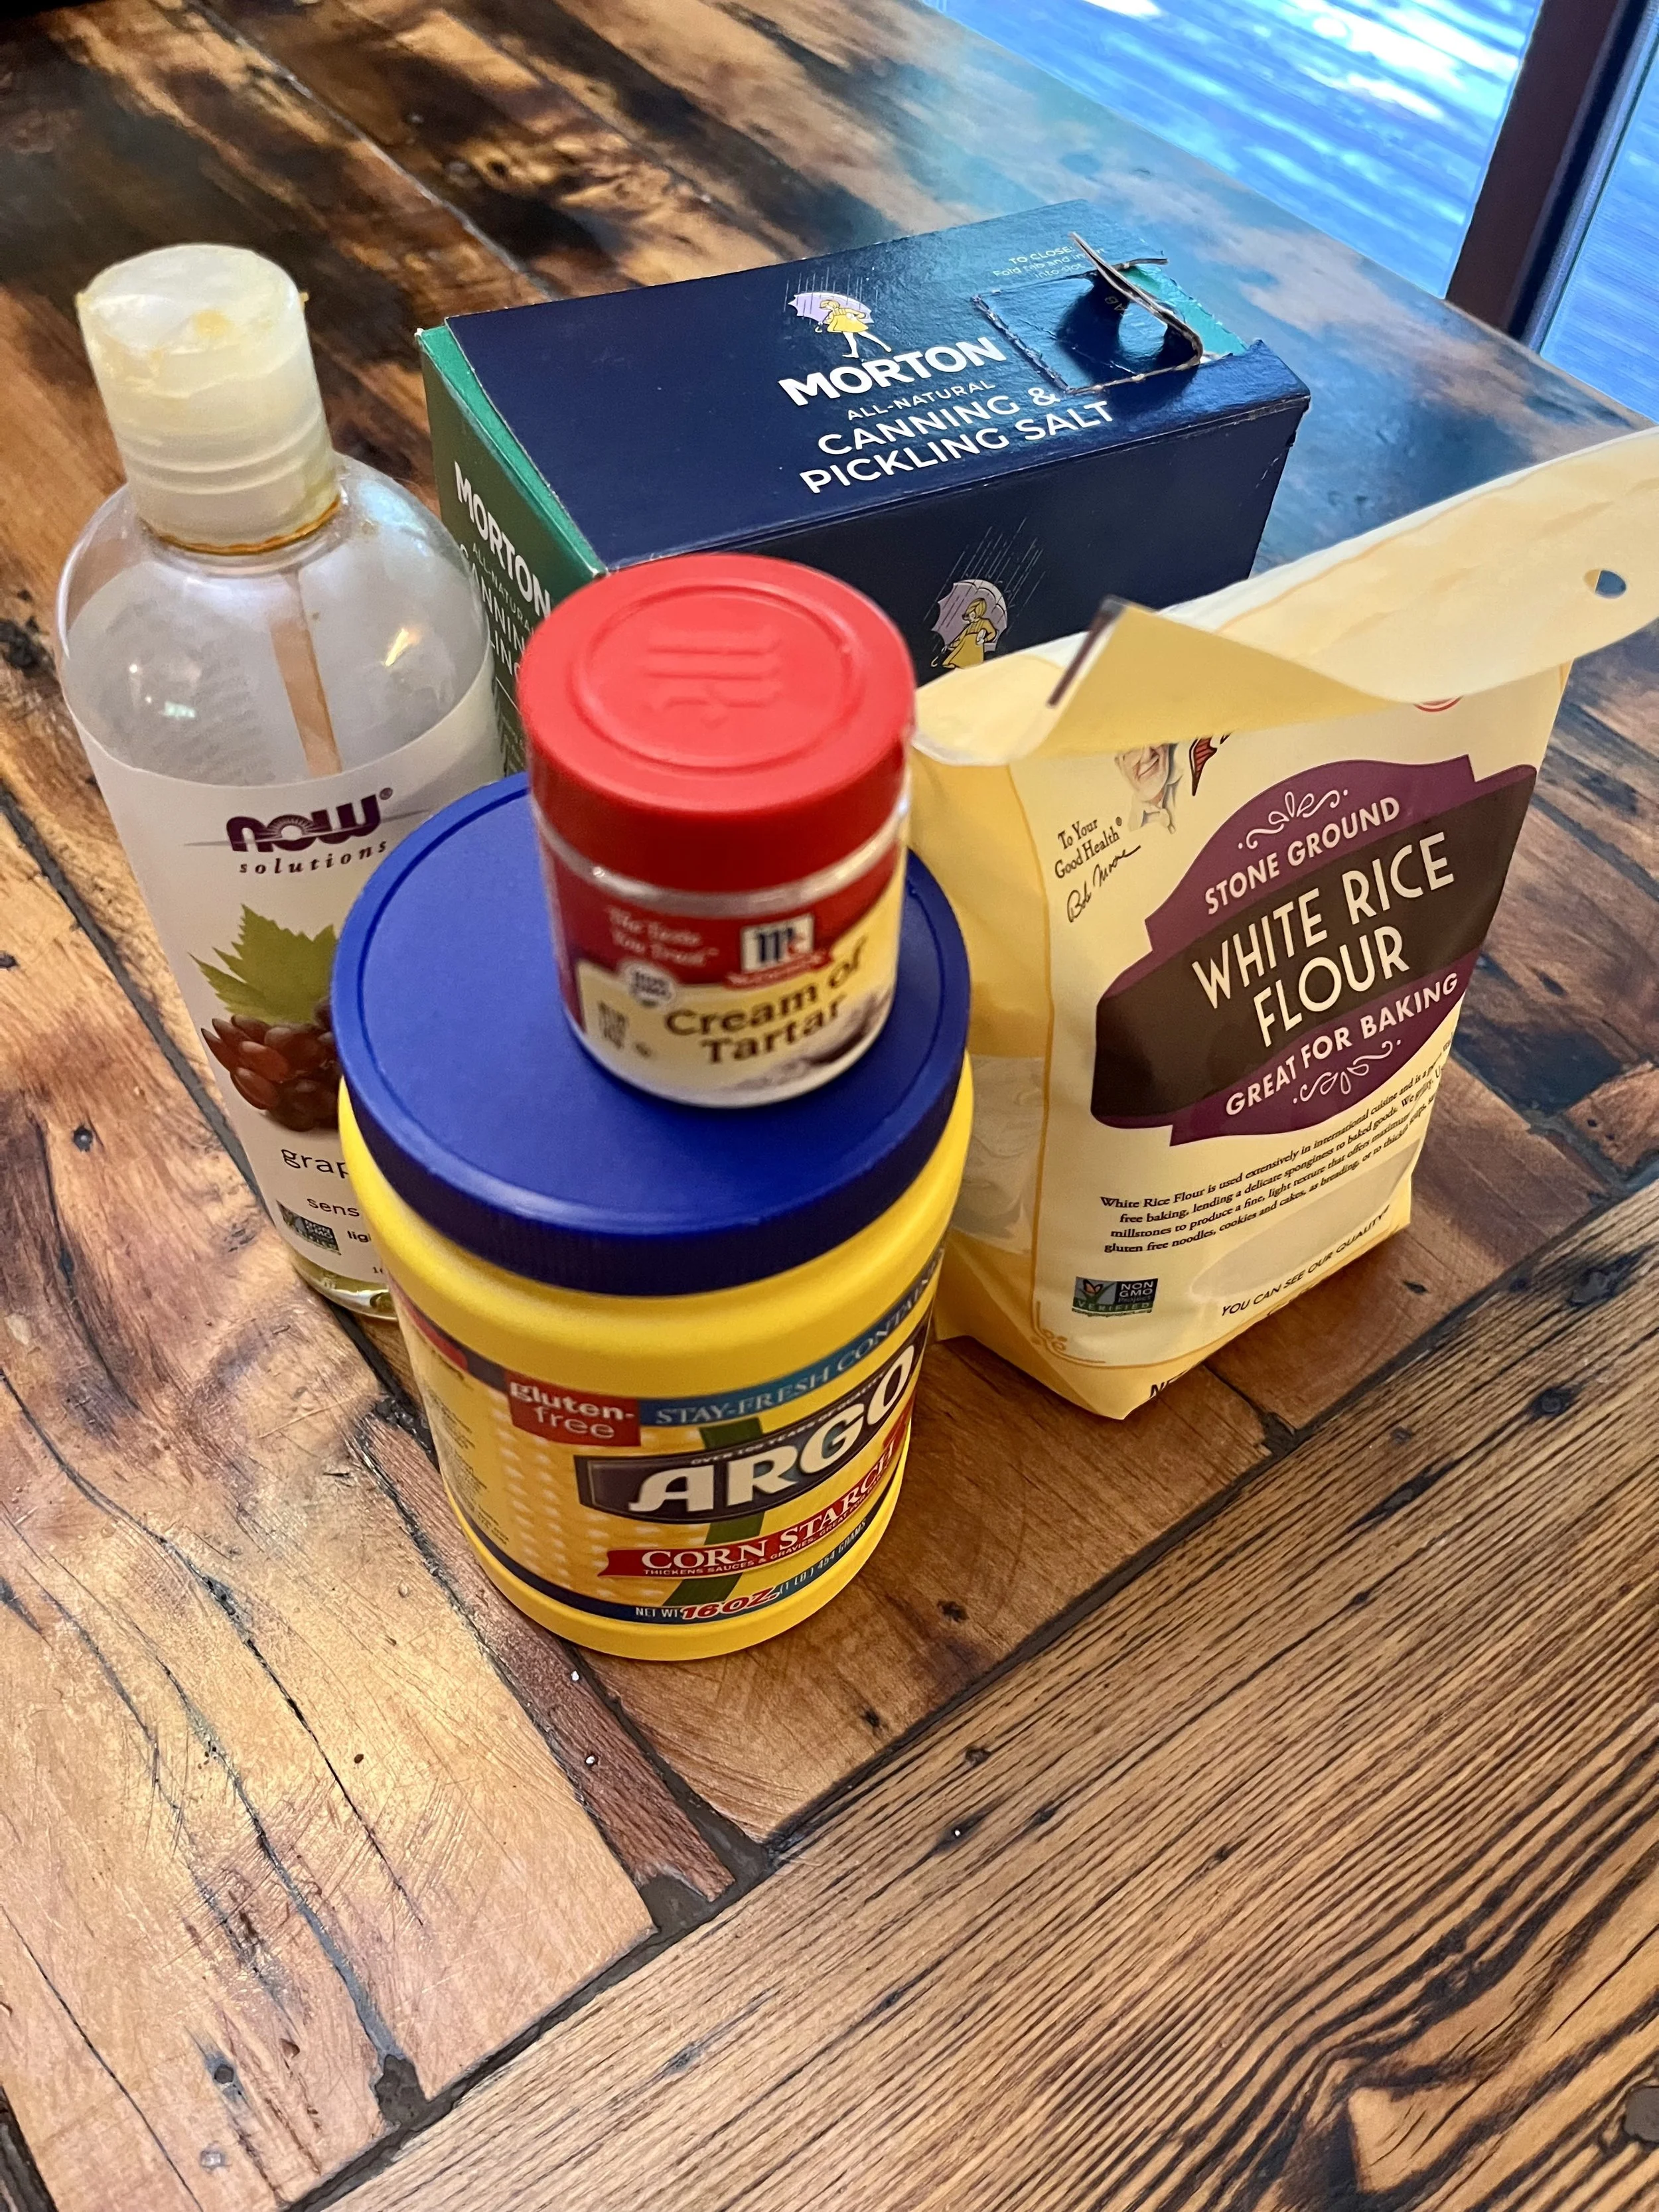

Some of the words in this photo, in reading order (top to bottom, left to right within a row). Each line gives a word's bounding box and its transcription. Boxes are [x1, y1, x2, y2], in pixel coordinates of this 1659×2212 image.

[993, 267, 1021, 277] Fold
[1046, 256, 1070, 267] and
[1009, 256, 1028, 265] TO
[1029, 246, 1074, 261] CLOSE:
[1035, 268, 1058, 279] into
[778, 337, 1007, 406] MORTON
[847, 379, 996, 421] ALL-NATURAL
[799, 427, 1010, 494] PICKLING
[1015, 400, 1114, 441] SALT
[818, 396, 1021, 456] CANNING
[1028, 386, 1061, 406] &
[455, 461, 551, 620] MORTON
[240, 840, 387, 874] solutions
[1054, 848, 1084, 879] Good
[1057, 830, 1074, 850] To
[1072, 818, 1098, 841] Your
[1204, 852, 1281, 915] STONE
[1287, 796, 1400, 867] GROUND
[1191, 887, 1328, 1009] WHITE
[1341, 831, 1455, 925] RICE
[666, 983, 818, 1036] Cream
[827, 935, 868, 989] of
[1253, 926, 1410, 1047] FLOUR
[699, 993, 847, 1064] Tartar
[1226, 1055, 1297, 1116] GREAT
[1301, 1027, 1352, 1069] FOR
[1360, 972, 1458, 1039] BAKING
[1100, 1196, 1140, 1208] White
[1143, 1197, 1171, 1208] Rice
[1173, 1188, 1205, 1203] Flour
[1207, 1184, 1216, 1194] is
[1219, 1172, 1243, 1189] used
[1245, 1149, 1299, 1179] extensively
[1301, 1145, 1311, 1155] in
[1313, 1108, 1369, 1149] international
[1370, 1092, 1398, 1115] cuisine
[1398, 1077, 1414, 1096] and
[1119, 1213, 1143, 1223] free
[1146, 1209, 1190, 1223] baking,
[1192, 1193, 1234, 1214] lending
[1244, 1171, 1283, 1194] delicate
[1283, 1147, 1334, 1178] sponginess
[1336, 1141, 1346, 1151] to
[1348, 1121, 1373, 1145] baked
[1104, 1242, 1143, 1254] gluten
[1145, 1241, 1169, 1252] free
[1171, 1230, 1216, 1248] noodles,
[1219, 1211, 1258, 1232] cookies
[1258, 1201, 1278, 1217] and
[1279, 1189, 1307, 1207] cakes,
[1308, 1182, 1319, 1193] as
[1362, 1151, 1372, 1162] or
[1110, 1227, 1172, 1238] millstones
[1190, 1207, 1234, 1231] produce
[1243, 1196, 1265, 1209] fine,
[1267, 1181, 1292, 1199] light
[1293, 1165, 1327, 1187] texture
[1327, 1153, 1346, 1169] that
[1346, 1140, 1370, 1158] offers
[347, 1230, 372, 1243] lig
[1077, 1299, 1150, 1311] VERIFIED
[1118, 1288, 1153, 1297] GMO
[1120, 1280, 1154, 1291] NON
[1221, 1298, 1252, 1317] YOU
[1253, 1284, 1282, 1305] CAN
[1283, 1269, 1307, 1290] SEE
[1307, 1251, 1334, 1274] OUR
[509, 1381, 635, 1421] gluten-
[534, 1406, 615, 1439] free
[655, 1364, 830, 1424] STAY-FRESH
[629, 1345, 915, 1514] ARGO
[641, 1538, 768, 1570] CORN
[779, 1438, 896, 1552] STARCH
[707, 1560, 755, 1573] SAUCES
[819, 1511, 848, 1536] GREAT
[635, 1606, 656, 1617] NET
[817, 1551, 835, 1569] 454
